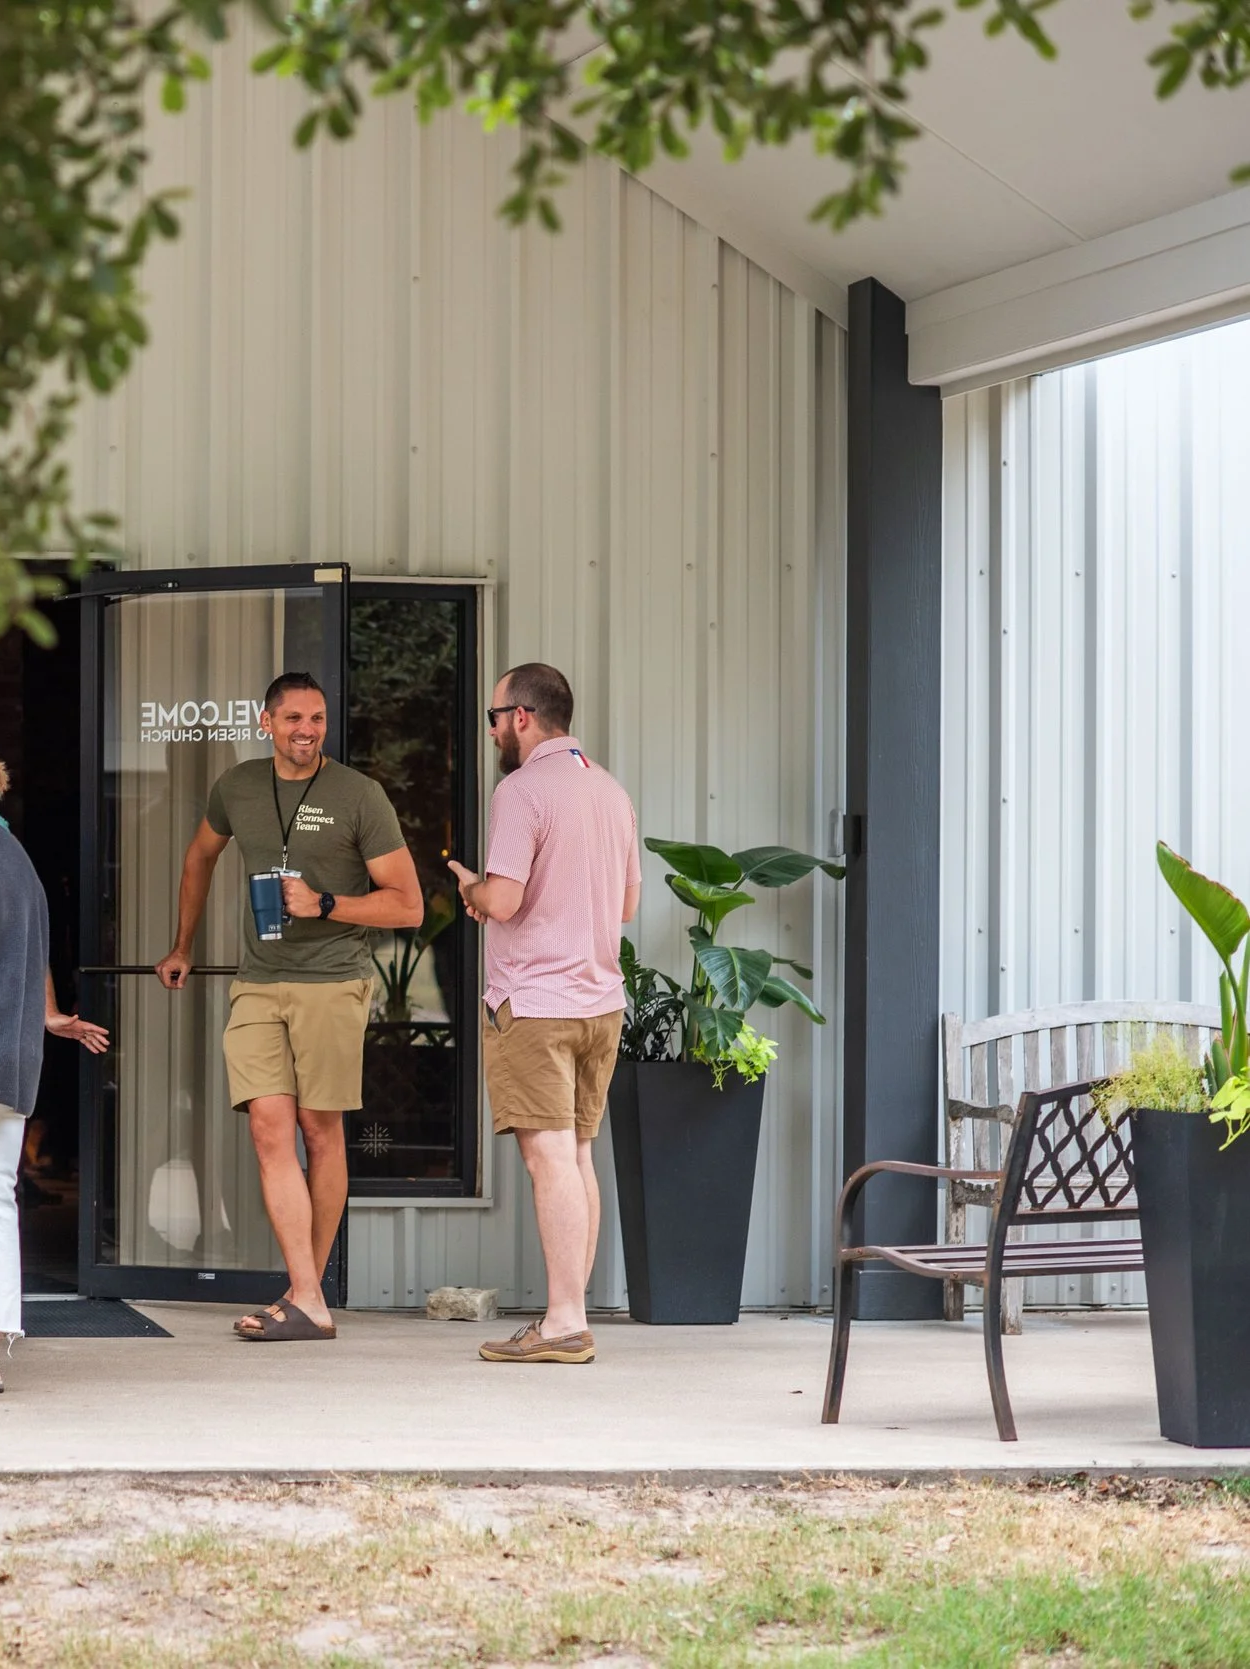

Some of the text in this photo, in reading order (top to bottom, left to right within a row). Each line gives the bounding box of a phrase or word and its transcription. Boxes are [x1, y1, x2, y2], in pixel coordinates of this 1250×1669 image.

[298, 804, 324, 815] Risen
[296, 812, 335, 825] Connect
[295, 821, 321, 832] Team
